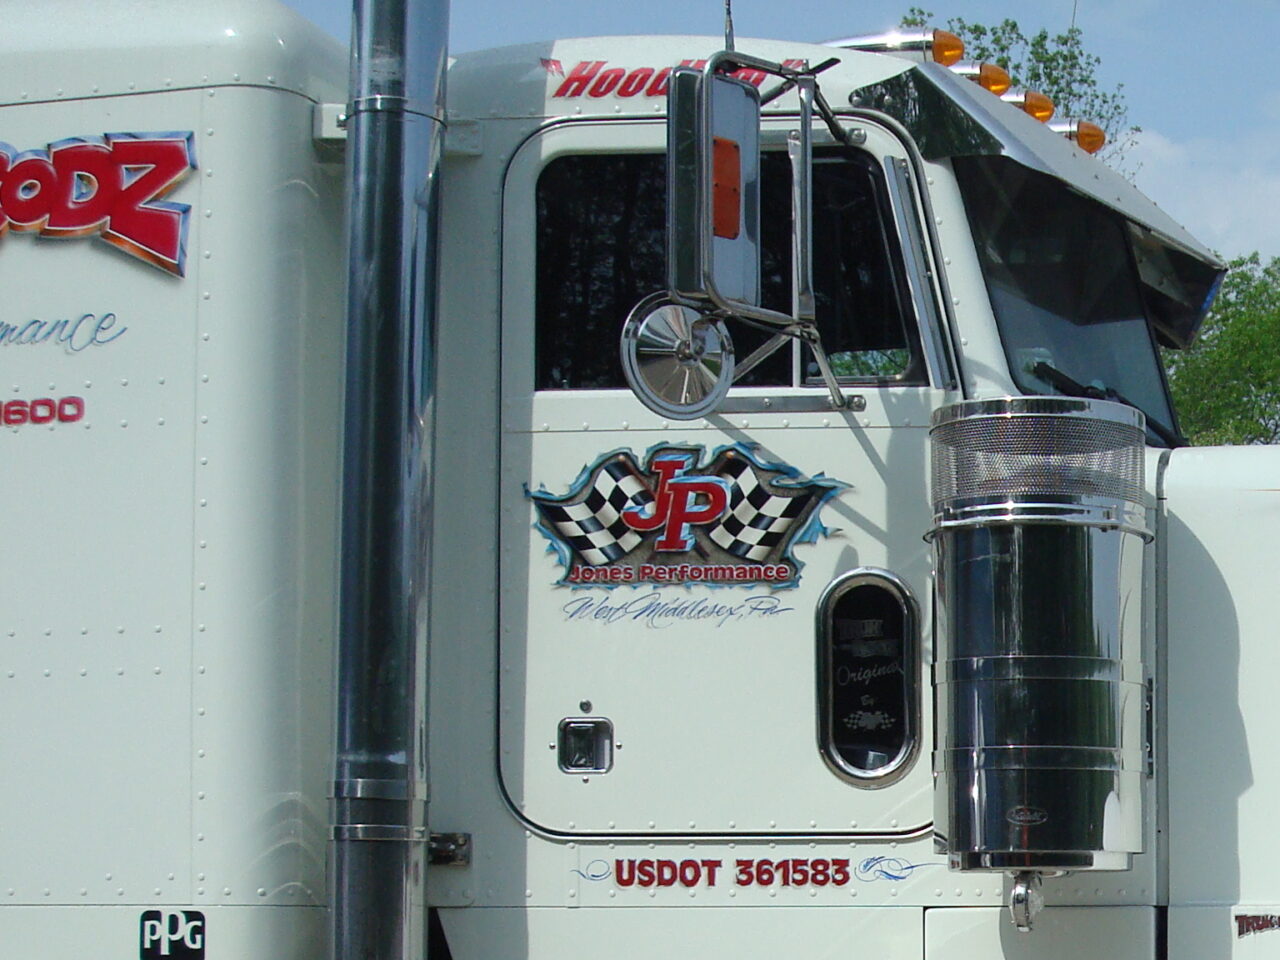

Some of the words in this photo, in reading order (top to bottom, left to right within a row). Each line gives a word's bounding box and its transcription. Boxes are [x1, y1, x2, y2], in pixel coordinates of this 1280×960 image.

[0, 130, 198, 279] ODZ
[0, 395, 85, 426] 600
[569, 564, 633, 583] Jones
[638, 562, 790, 583] Performance
[563, 596, 628, 624] West
[614, 858, 723, 887] USDOT
[734, 857, 851, 887] 361583
[143, 910, 203, 956] PPG
